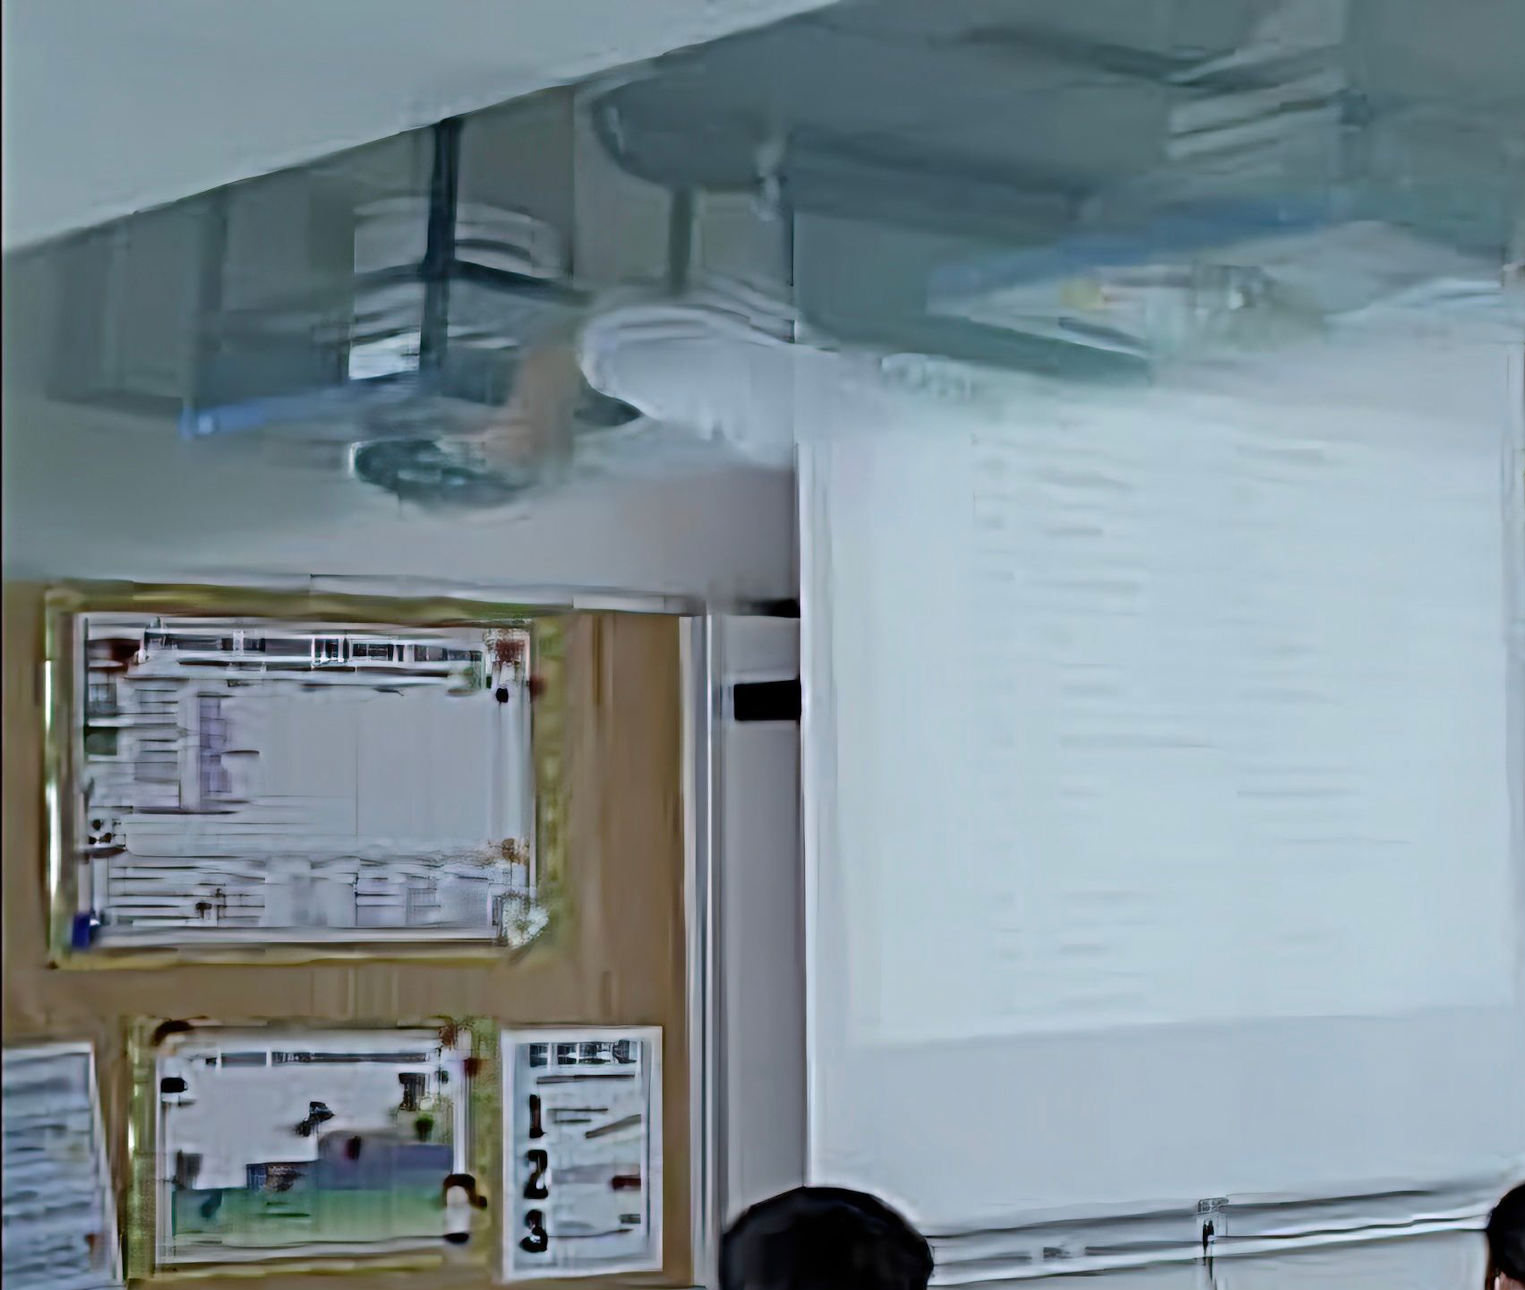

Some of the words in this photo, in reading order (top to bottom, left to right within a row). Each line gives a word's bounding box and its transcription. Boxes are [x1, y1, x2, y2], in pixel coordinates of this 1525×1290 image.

[528, 1093, 546, 1139] 1
[523, 1149, 549, 1200] 2
[519, 1208, 549, 1253] 3
